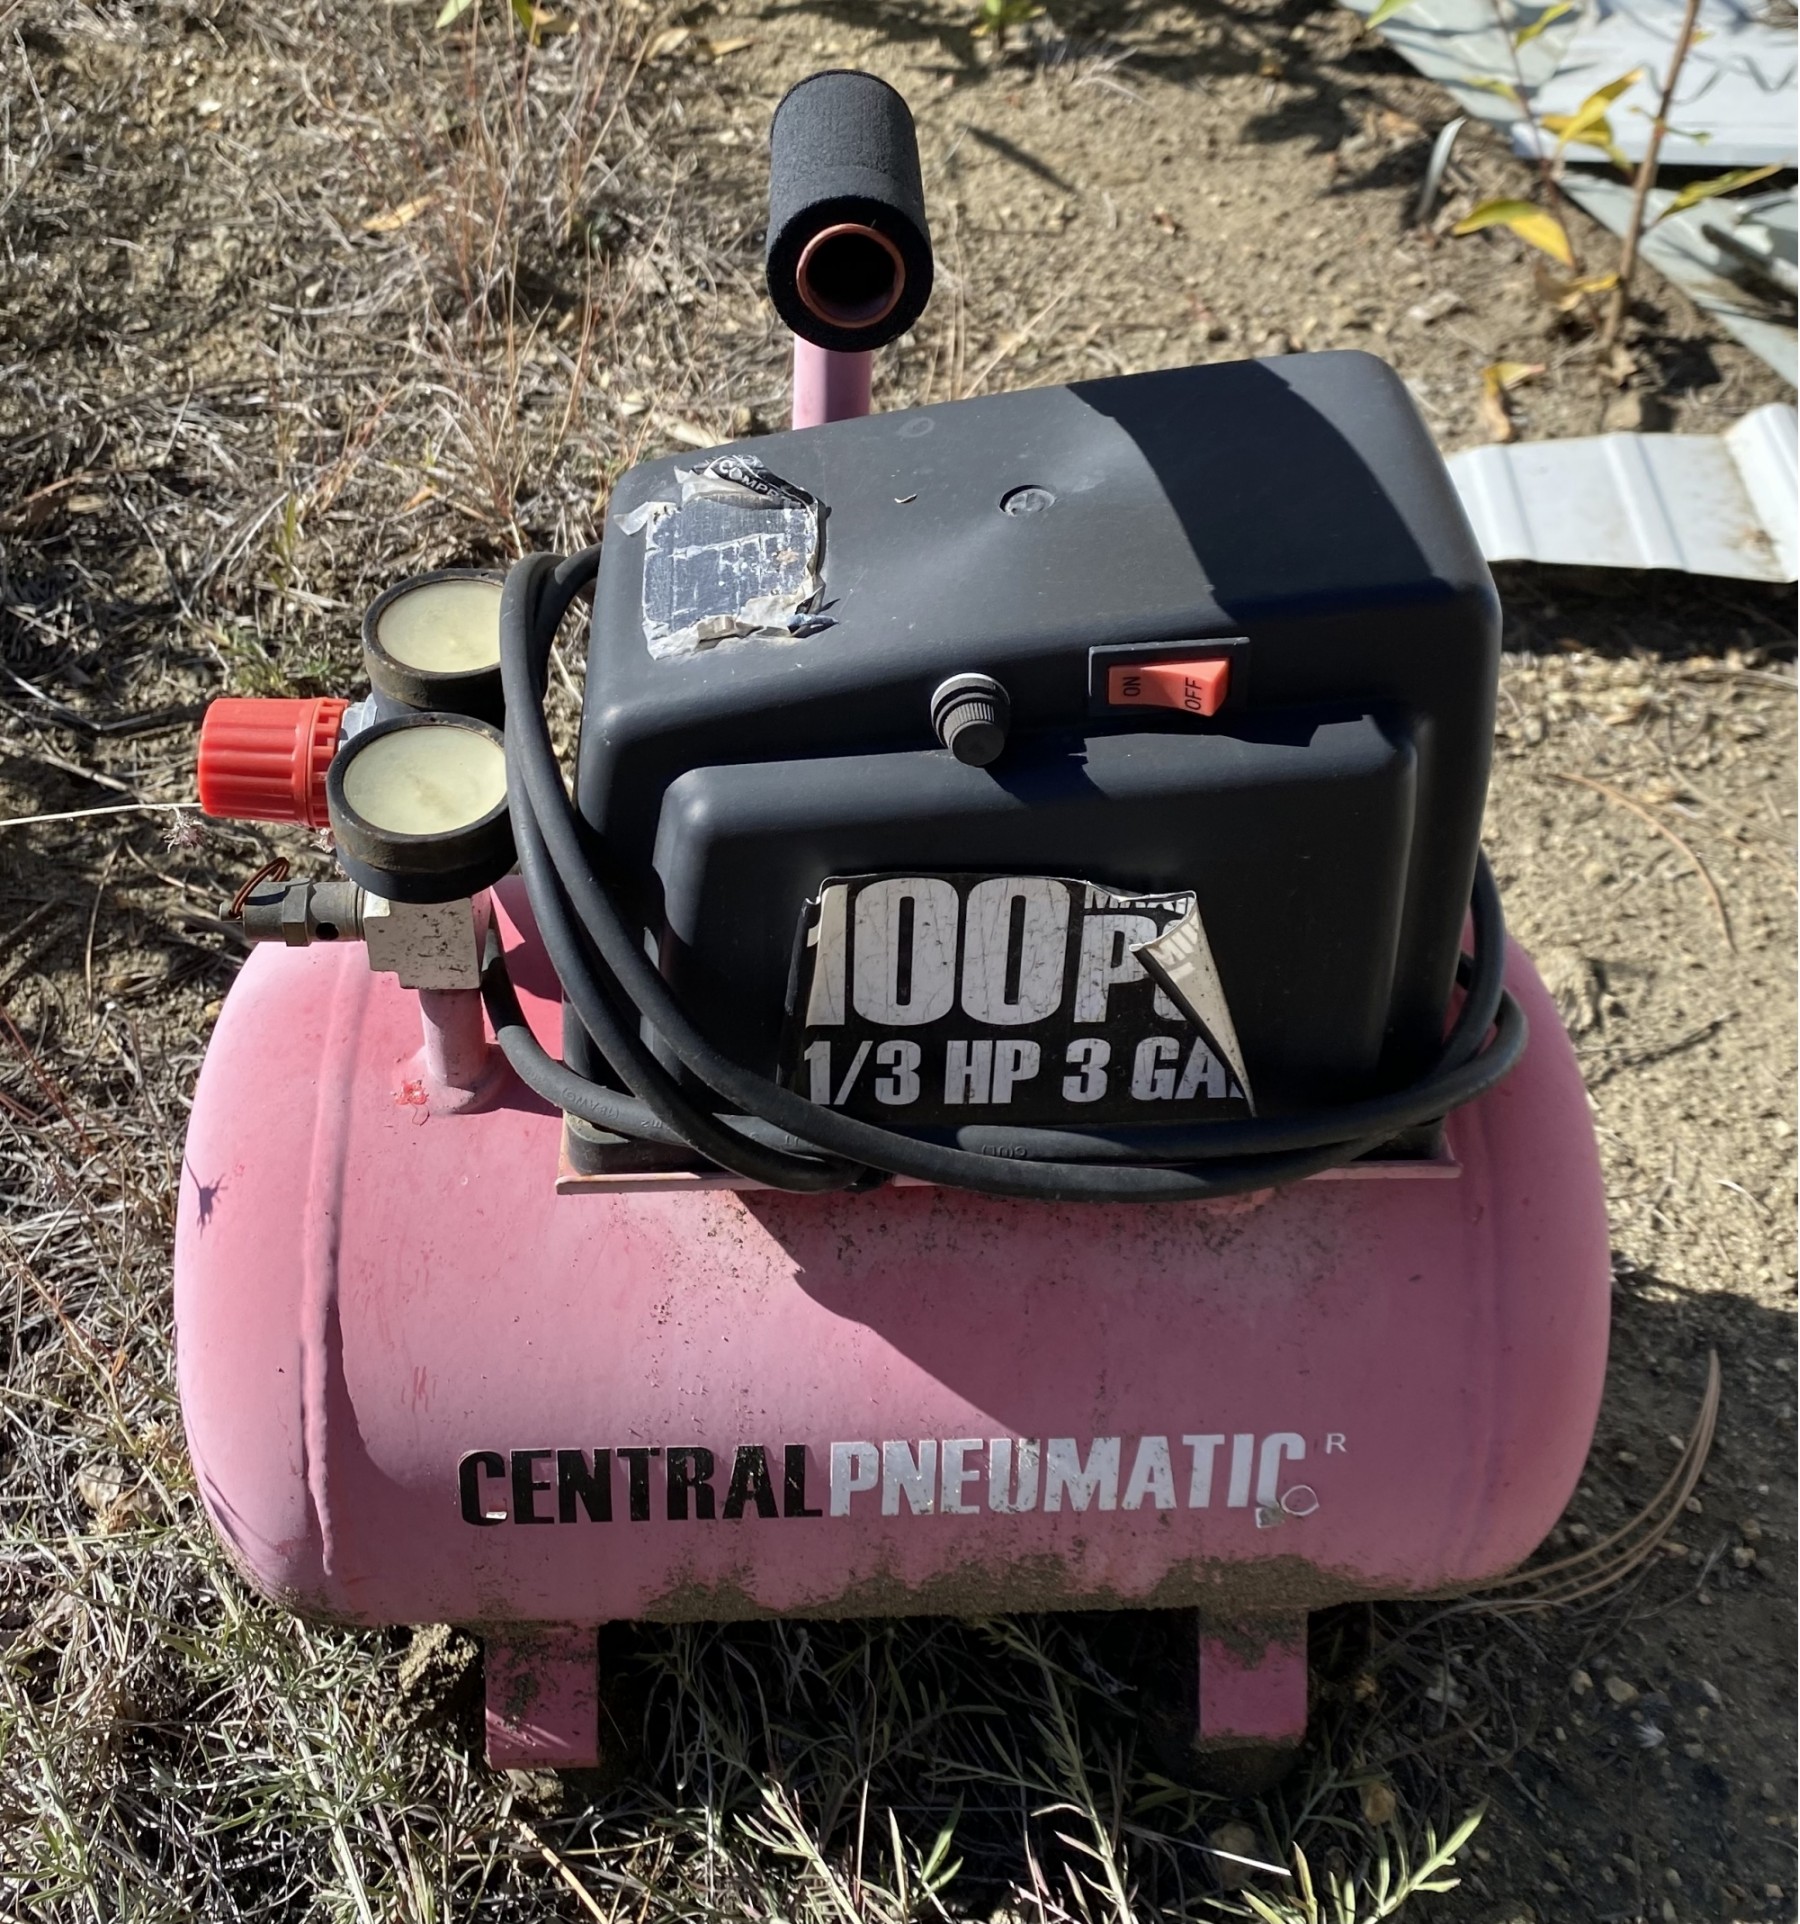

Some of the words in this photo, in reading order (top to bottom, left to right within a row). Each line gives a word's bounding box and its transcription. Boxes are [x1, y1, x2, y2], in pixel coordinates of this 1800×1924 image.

[1123, 676, 1141, 697] ON
[1185, 677, 1203, 711] OFF
[804, 1039, 922, 1106] 1/3
[944, 1039, 1041, 1104] HP
[1062, 1037, 1111, 1103] 3
[1131, 1036, 1246, 1101] GA
